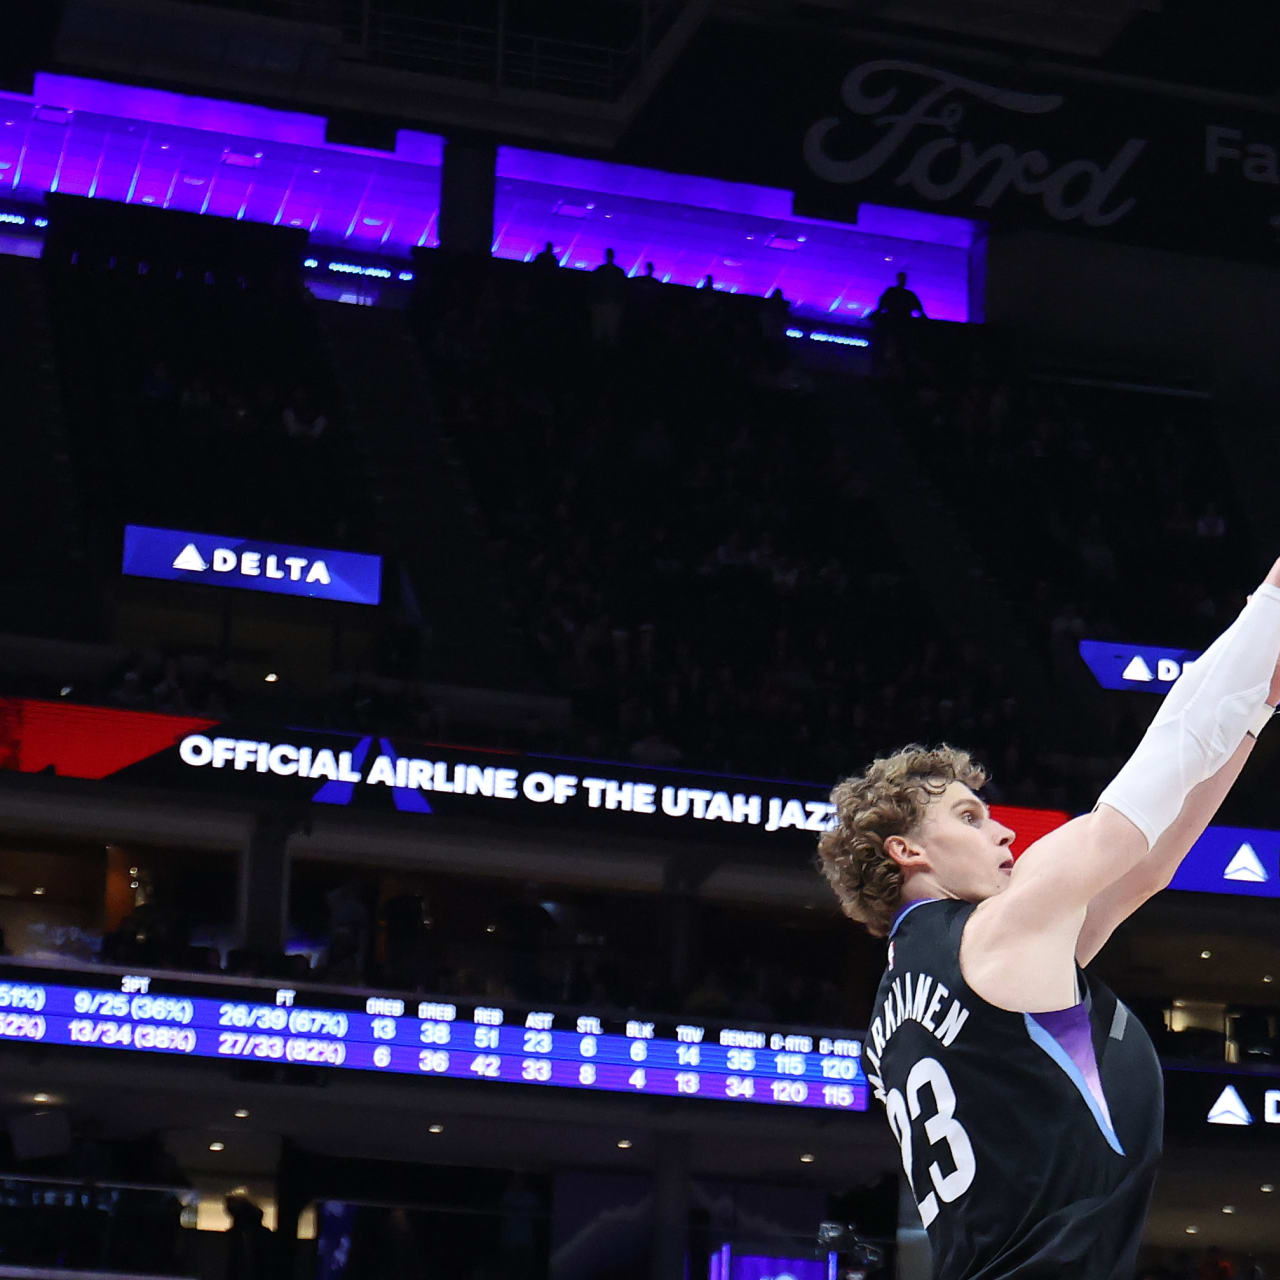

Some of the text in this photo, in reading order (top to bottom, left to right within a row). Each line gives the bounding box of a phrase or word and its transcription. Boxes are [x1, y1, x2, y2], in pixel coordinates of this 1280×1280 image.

[803, 59, 1147, 226] Ford
[212, 548, 332, 585] DELTA
[179, 734, 362, 783] OFFICIAL
[366, 755, 519, 799] AIRLINE
[522, 772, 578, 805] OF
[581, 778, 657, 814] THE
[661, 786, 762, 825] UTAH
[371, 1016, 397, 1040] 13
[523, 1030, 553, 1054] 23
[579, 1035, 598, 1058] 6
[629, 1040, 649, 1062] 6
[676, 1044, 701, 1067] 14
[820, 1056, 859, 1080] 120
[373, 1045, 392, 1068] 6
[470, 1054, 502, 1077] 42
[521, 1058, 552, 1082] 33
[627, 1066, 647, 1090] 4
[675, 1071, 700, 1094] 13
[724, 1075, 755, 1098] 34
[769, 1079, 809, 1103] 120
[885, 1057, 977, 1231] 23
